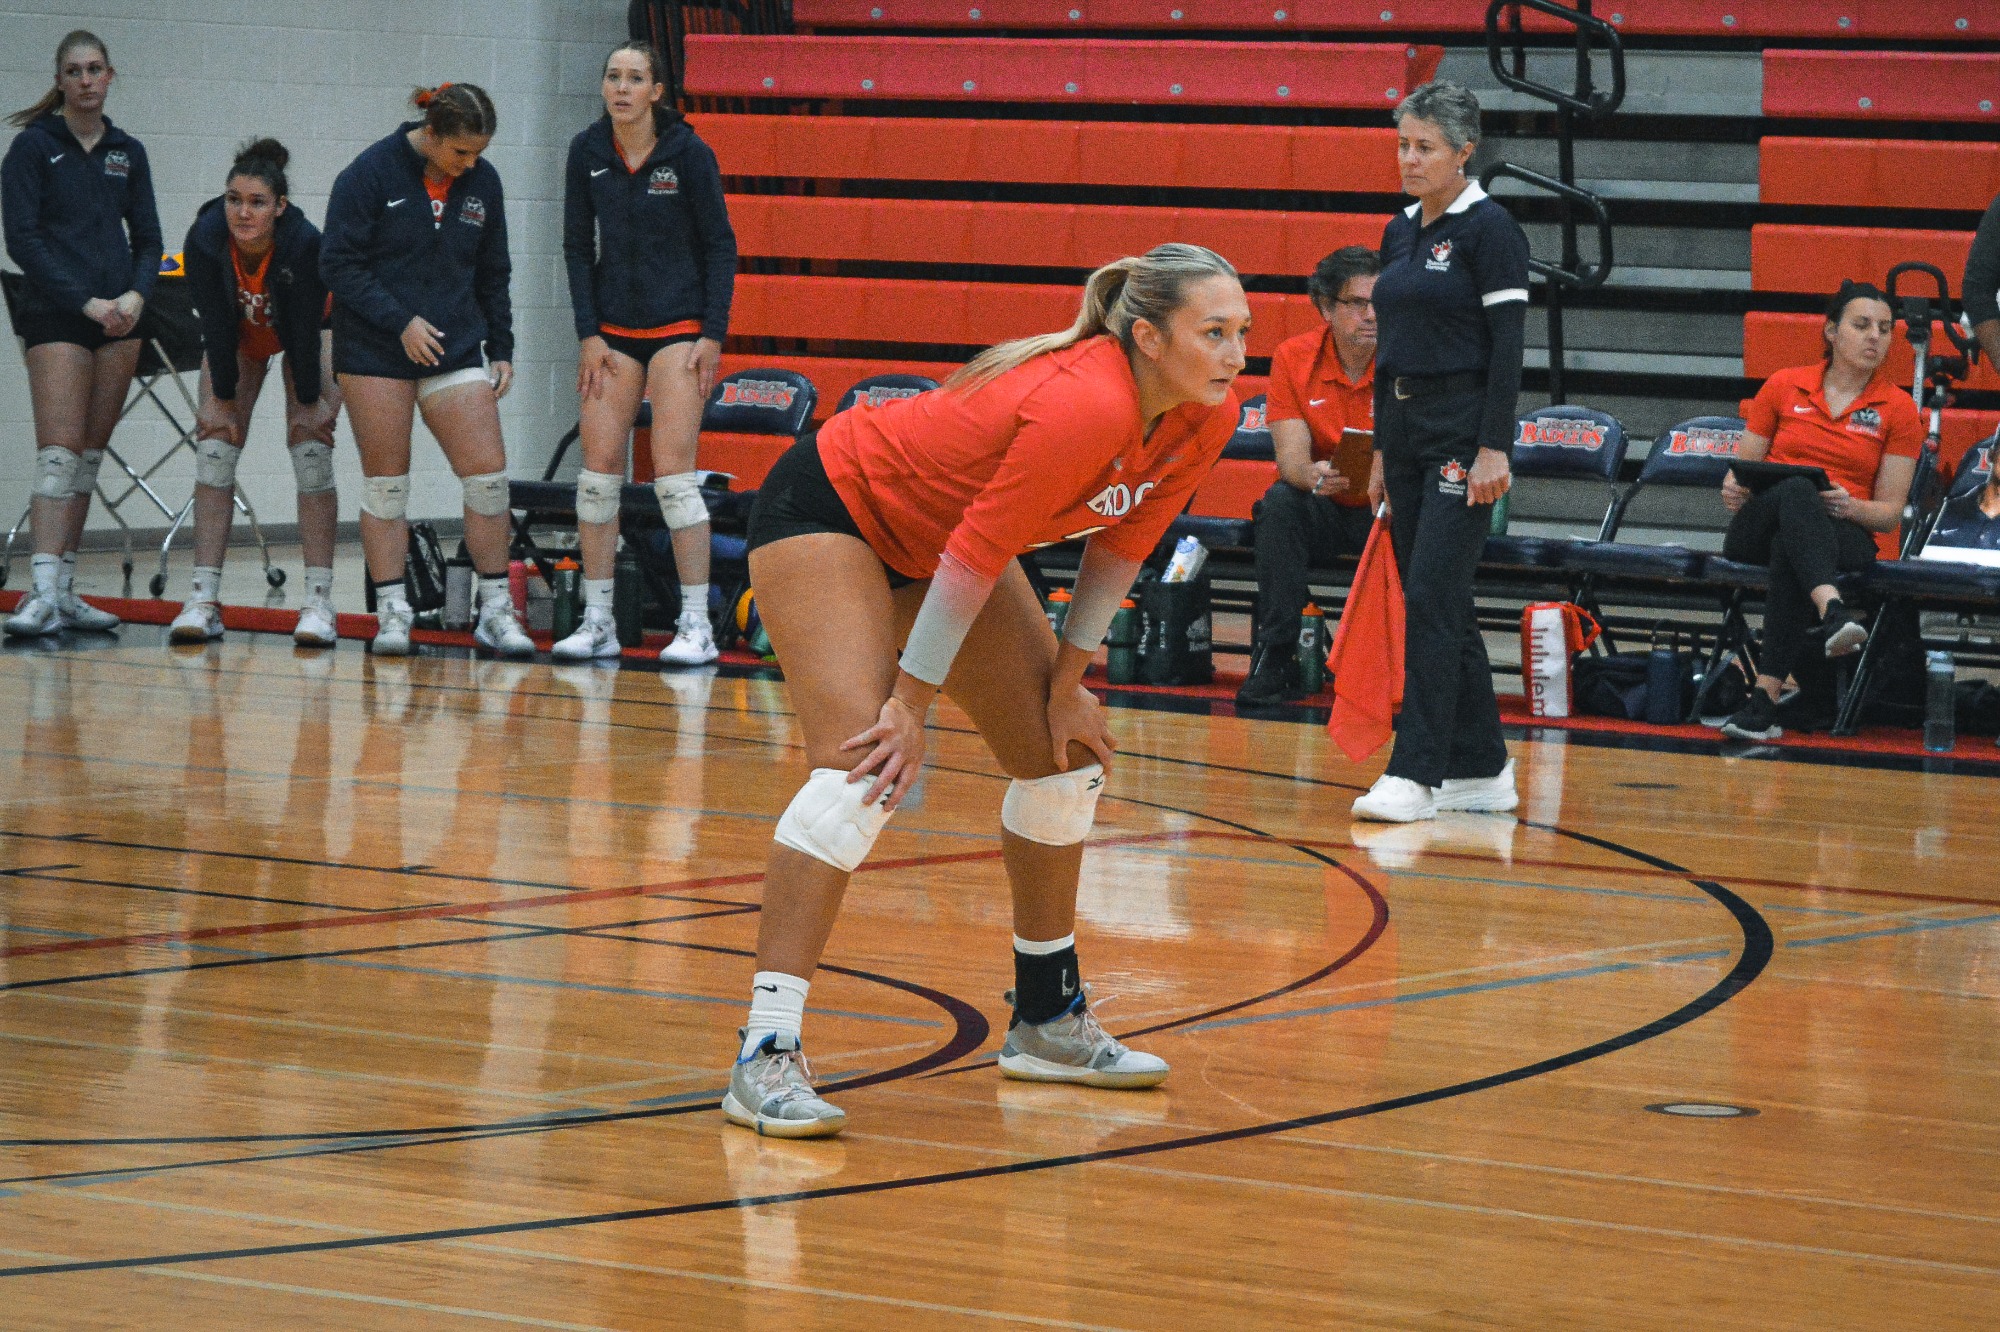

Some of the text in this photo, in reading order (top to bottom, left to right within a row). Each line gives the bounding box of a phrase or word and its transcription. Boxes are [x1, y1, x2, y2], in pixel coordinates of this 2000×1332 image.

[1520, 422, 1604, 449] BADGERS
[1669, 432, 1740, 456] BADGER
[1299, 628, 1314, 647] G
